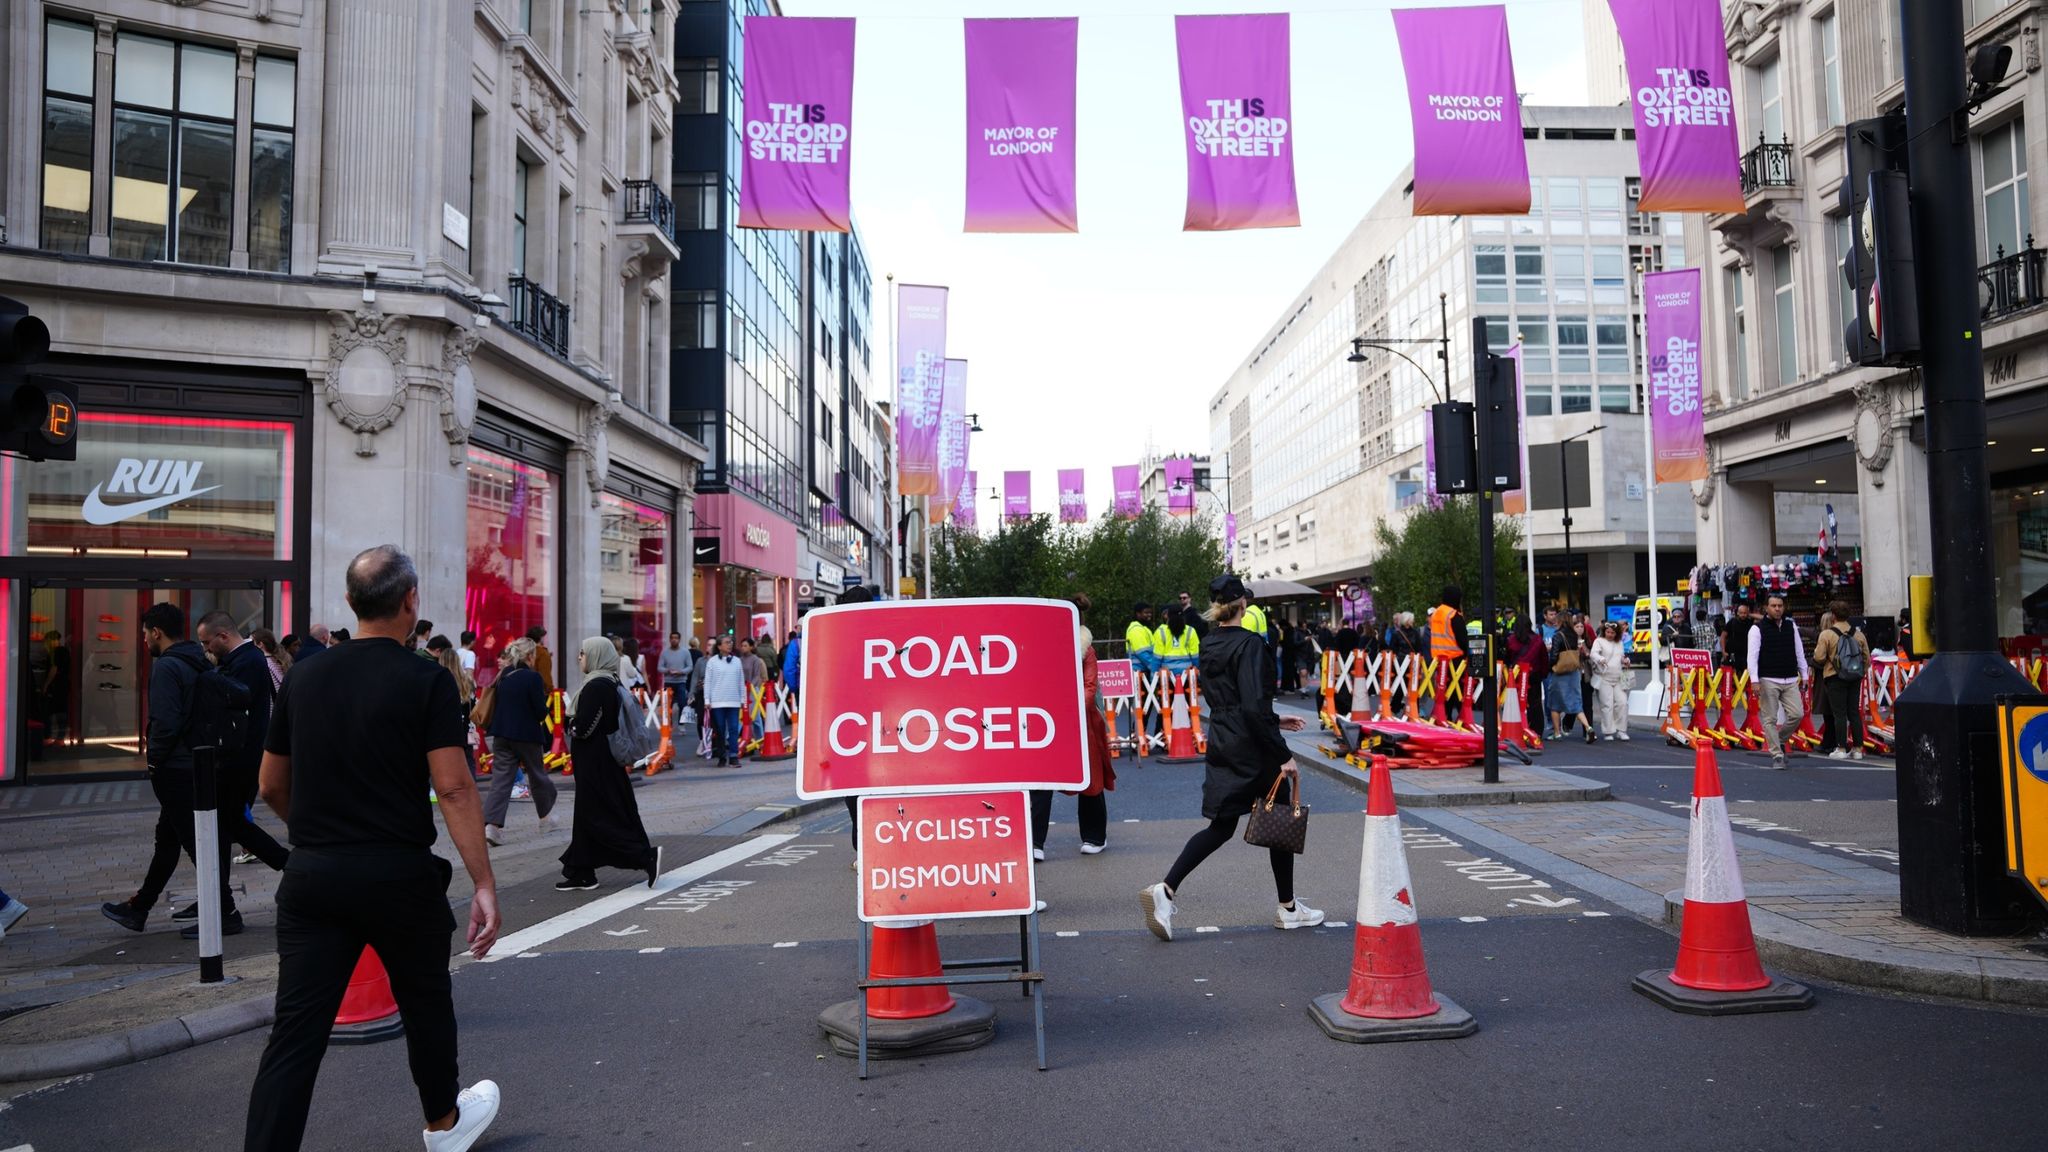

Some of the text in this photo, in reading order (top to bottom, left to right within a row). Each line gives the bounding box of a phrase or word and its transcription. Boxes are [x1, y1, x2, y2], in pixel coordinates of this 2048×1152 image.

[1656, 67, 1711, 88] THIS
[1206, 97, 1265, 119] THIS
[1429, 94, 1504, 108] MAYOR OF
[1637, 86, 1731, 108] OXFORD
[768, 103, 825, 124] THIS
[1436, 108, 1502, 122] LONDON
[1644, 105, 1731, 127] STREET
[746, 120, 848, 145] OXFORD
[984, 127, 1058, 141] MAYOR OF
[1189, 117, 1288, 138] OXFORD
[749, 140, 843, 164] STREET
[989, 141, 1053, 156] LONDON
[1195, 136, 1284, 157] STREET
[1655, 291, 1691, 301] MAYOR OF
[1657, 298, 1689, 308] LONDON
[1652, 355, 1668, 400] THIS
[1666, 335, 1685, 417] OXFORD
[1683, 339, 1699, 412] STREET
[1990, 352, 2018, 385] H&M
[912, 348, 931, 429] OXFORD
[924, 353, 945, 426] STREET
[50, 404, 69, 436] 12
[1774, 418, 1791, 443] H&M
[106, 458, 204, 496] RUN
[747, 523, 770, 548] PANDORA
[863, 634, 1018, 680] ROAD
[1675, 653, 1708, 661] CYCLISTS
[828, 706, 1056, 757] CLOSED
[874, 815, 1013, 845] CYCLISTS
[644, 844, 834, 913] LOOK RIGHT
[871, 861, 1019, 890] DISMOUNT
